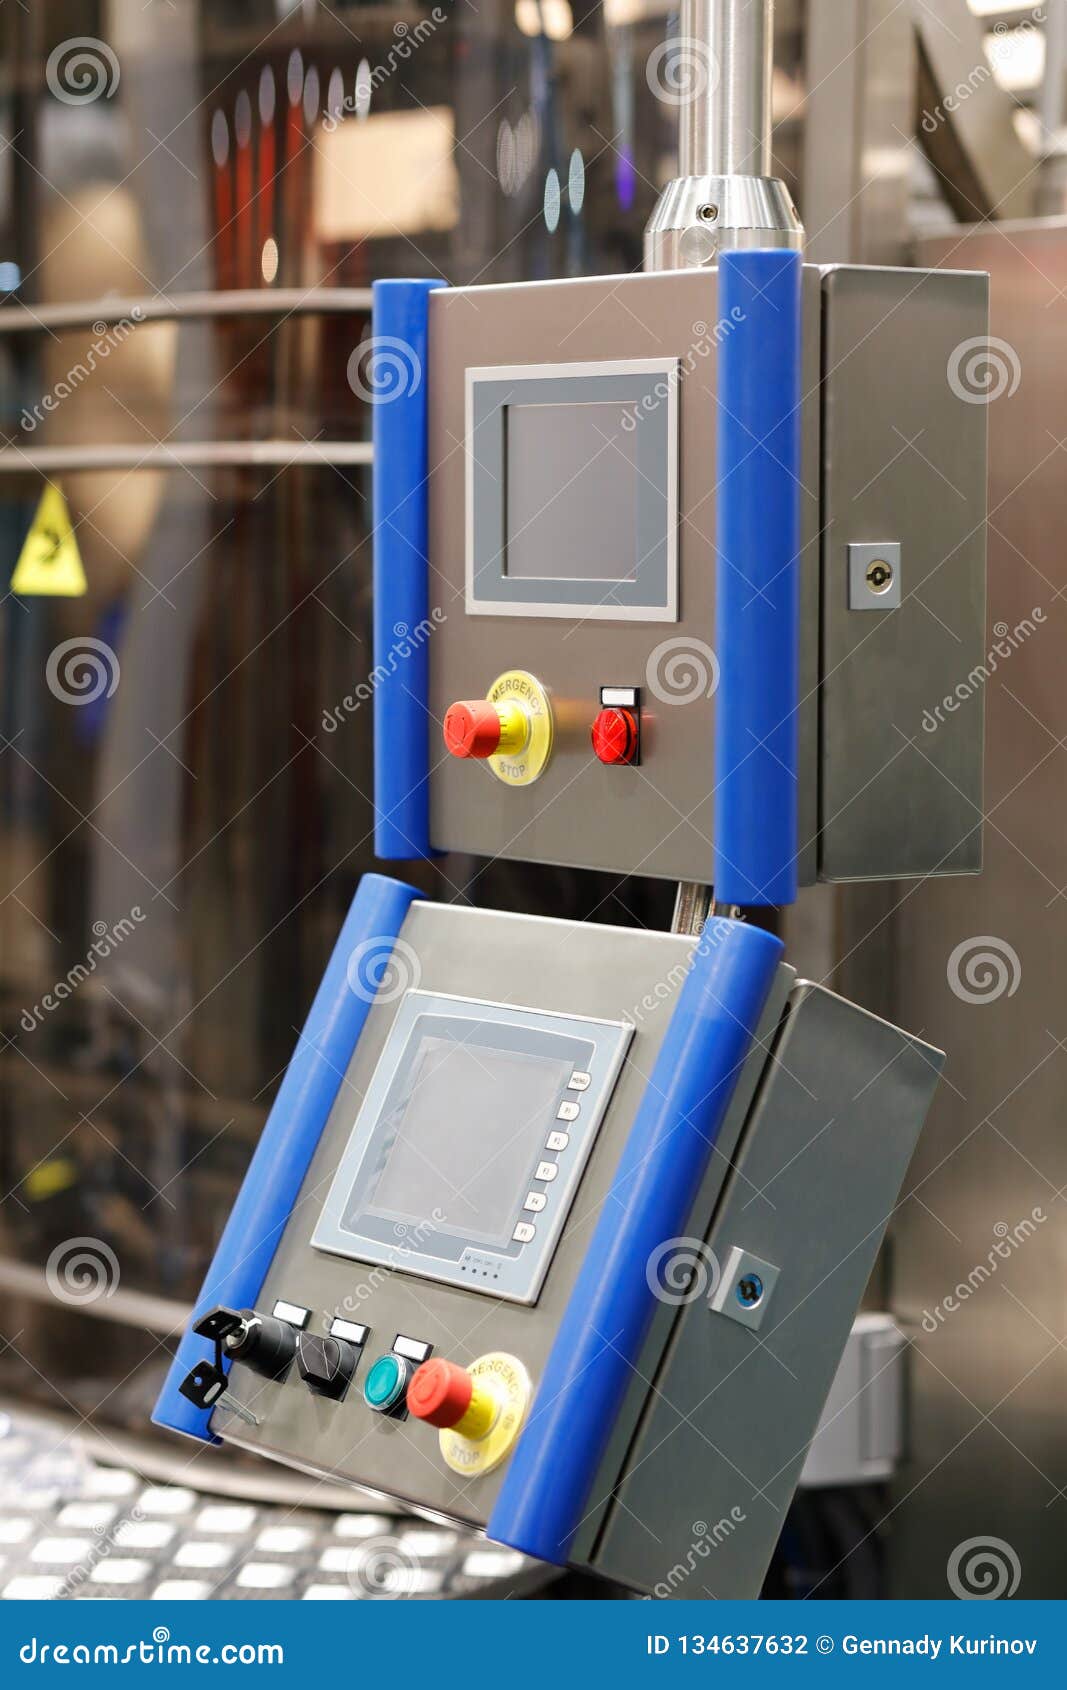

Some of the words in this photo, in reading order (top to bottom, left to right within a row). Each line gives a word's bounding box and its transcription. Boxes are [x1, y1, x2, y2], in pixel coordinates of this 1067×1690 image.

[491, 678, 544, 716] MERGENCY
[499, 760, 526, 778] STOP
[469, 1360, 520, 1403] MERGENCY
